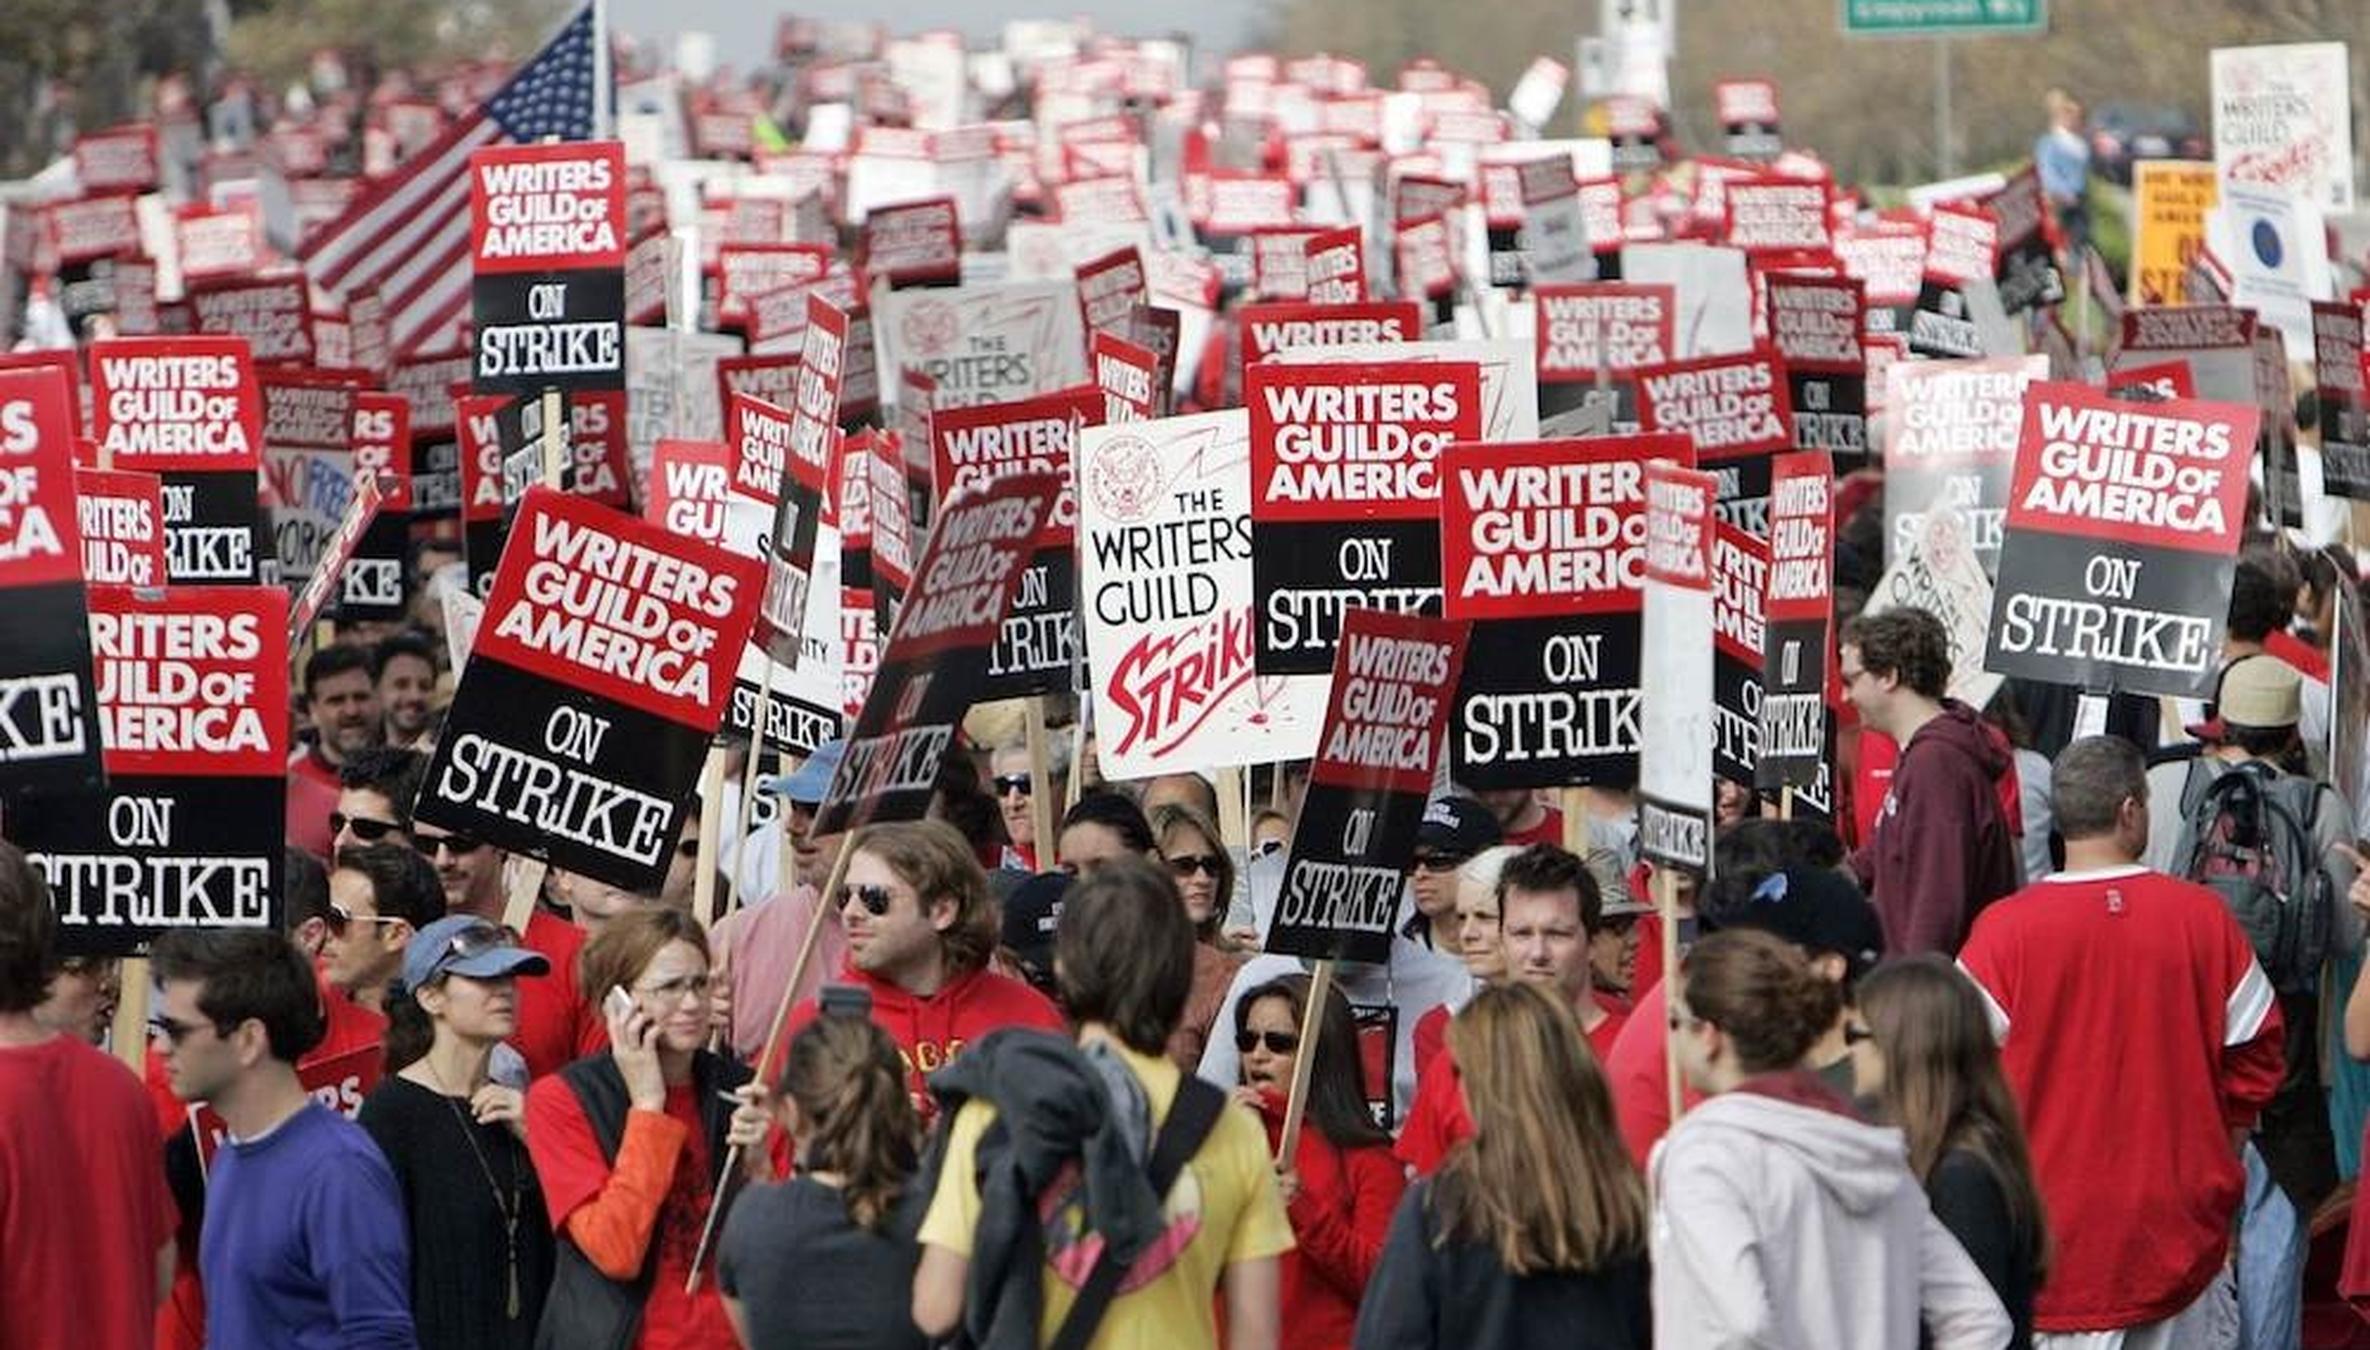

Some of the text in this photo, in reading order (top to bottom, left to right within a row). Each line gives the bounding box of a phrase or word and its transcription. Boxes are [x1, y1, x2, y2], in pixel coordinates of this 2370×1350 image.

[481, 159, 611, 196] WRITERS
[487, 194, 608, 226] GUILD OF
[481, 221, 618, 258] AMERICA
[528, 284, 567, 319] ON
[1543, 295, 1662, 320] WRITERS
[479, 321, 620, 377] STRIKE
[1251, 318, 1404, 352] WRITERS
[1549, 320, 1632, 346] GUID
[101, 356, 241, 391] WRITERS
[1643, 363, 1772, 401] WRITERS
[109, 390, 240, 424] GUILD OF
[740, 406, 789, 448] WRIT
[1263, 382, 1459, 424] WRITERS
[1654, 393, 1744, 426] GUILD
[1905, 401, 1999, 429] GUILD
[104, 421, 250, 456] AMERICA
[740, 437, 786, 472] GUI
[943, 418, 1073, 465] WRITER
[1273, 422, 1456, 463] GUILD OF
[1688, 412, 1787, 449] ERICA
[1792, 412, 1865, 450] RIKE
[1897, 426, 2019, 456] AMERIC
[2039, 403, 2232, 460] WRITERS
[1459, 461, 1645, 511] WRITER
[2040, 442, 2222, 496] GUILD OF
[78, 496, 153, 542] RITERS
[940, 497, 1043, 549] WRITERS
[1174, 487, 1224, 514] THE
[2022, 480, 2227, 535] AMERICA
[166, 527, 252, 579] RIKE
[1091, 513, 1255, 573] WRITERS
[1471, 507, 1648, 555] GUILD O
[80, 539, 153, 585] UILD OF
[533, 511, 739, 621] WRITERS
[1339, 538, 1392, 581] ON
[1460, 547, 1648, 598] AMERIC
[2085, 555, 2142, 601] ON
[524, 560, 718, 657] GUILD OF
[899, 584, 1007, 640] AMERICA
[1095, 572, 1219, 627] GUILD
[88, 613, 262, 661] RITERS
[494, 601, 712, 708] AMERICA
[987, 610, 1076, 677] TRIK
[2000, 593, 2212, 673] STRIKE
[1347, 632, 1453, 688] WRITERS
[1543, 635, 1602, 683] ON
[97, 661, 254, 707] UILD OF
[1341, 676, 1436, 726] GUILD OF
[99, 705, 271, 754] ERICA
[545, 704, 611, 767] ON
[1323, 721, 1431, 772] AMERICA
[1463, 689, 1644, 765] STRIK
[1759, 692, 1822, 759] STRIKE
[832, 723, 955, 803] STRIKE
[109, 796, 176, 848] ON
[437, 733, 674, 868] STRIKE
[1342, 808, 1376, 857] ON
[1279, 859, 1401, 934] STRIKE
